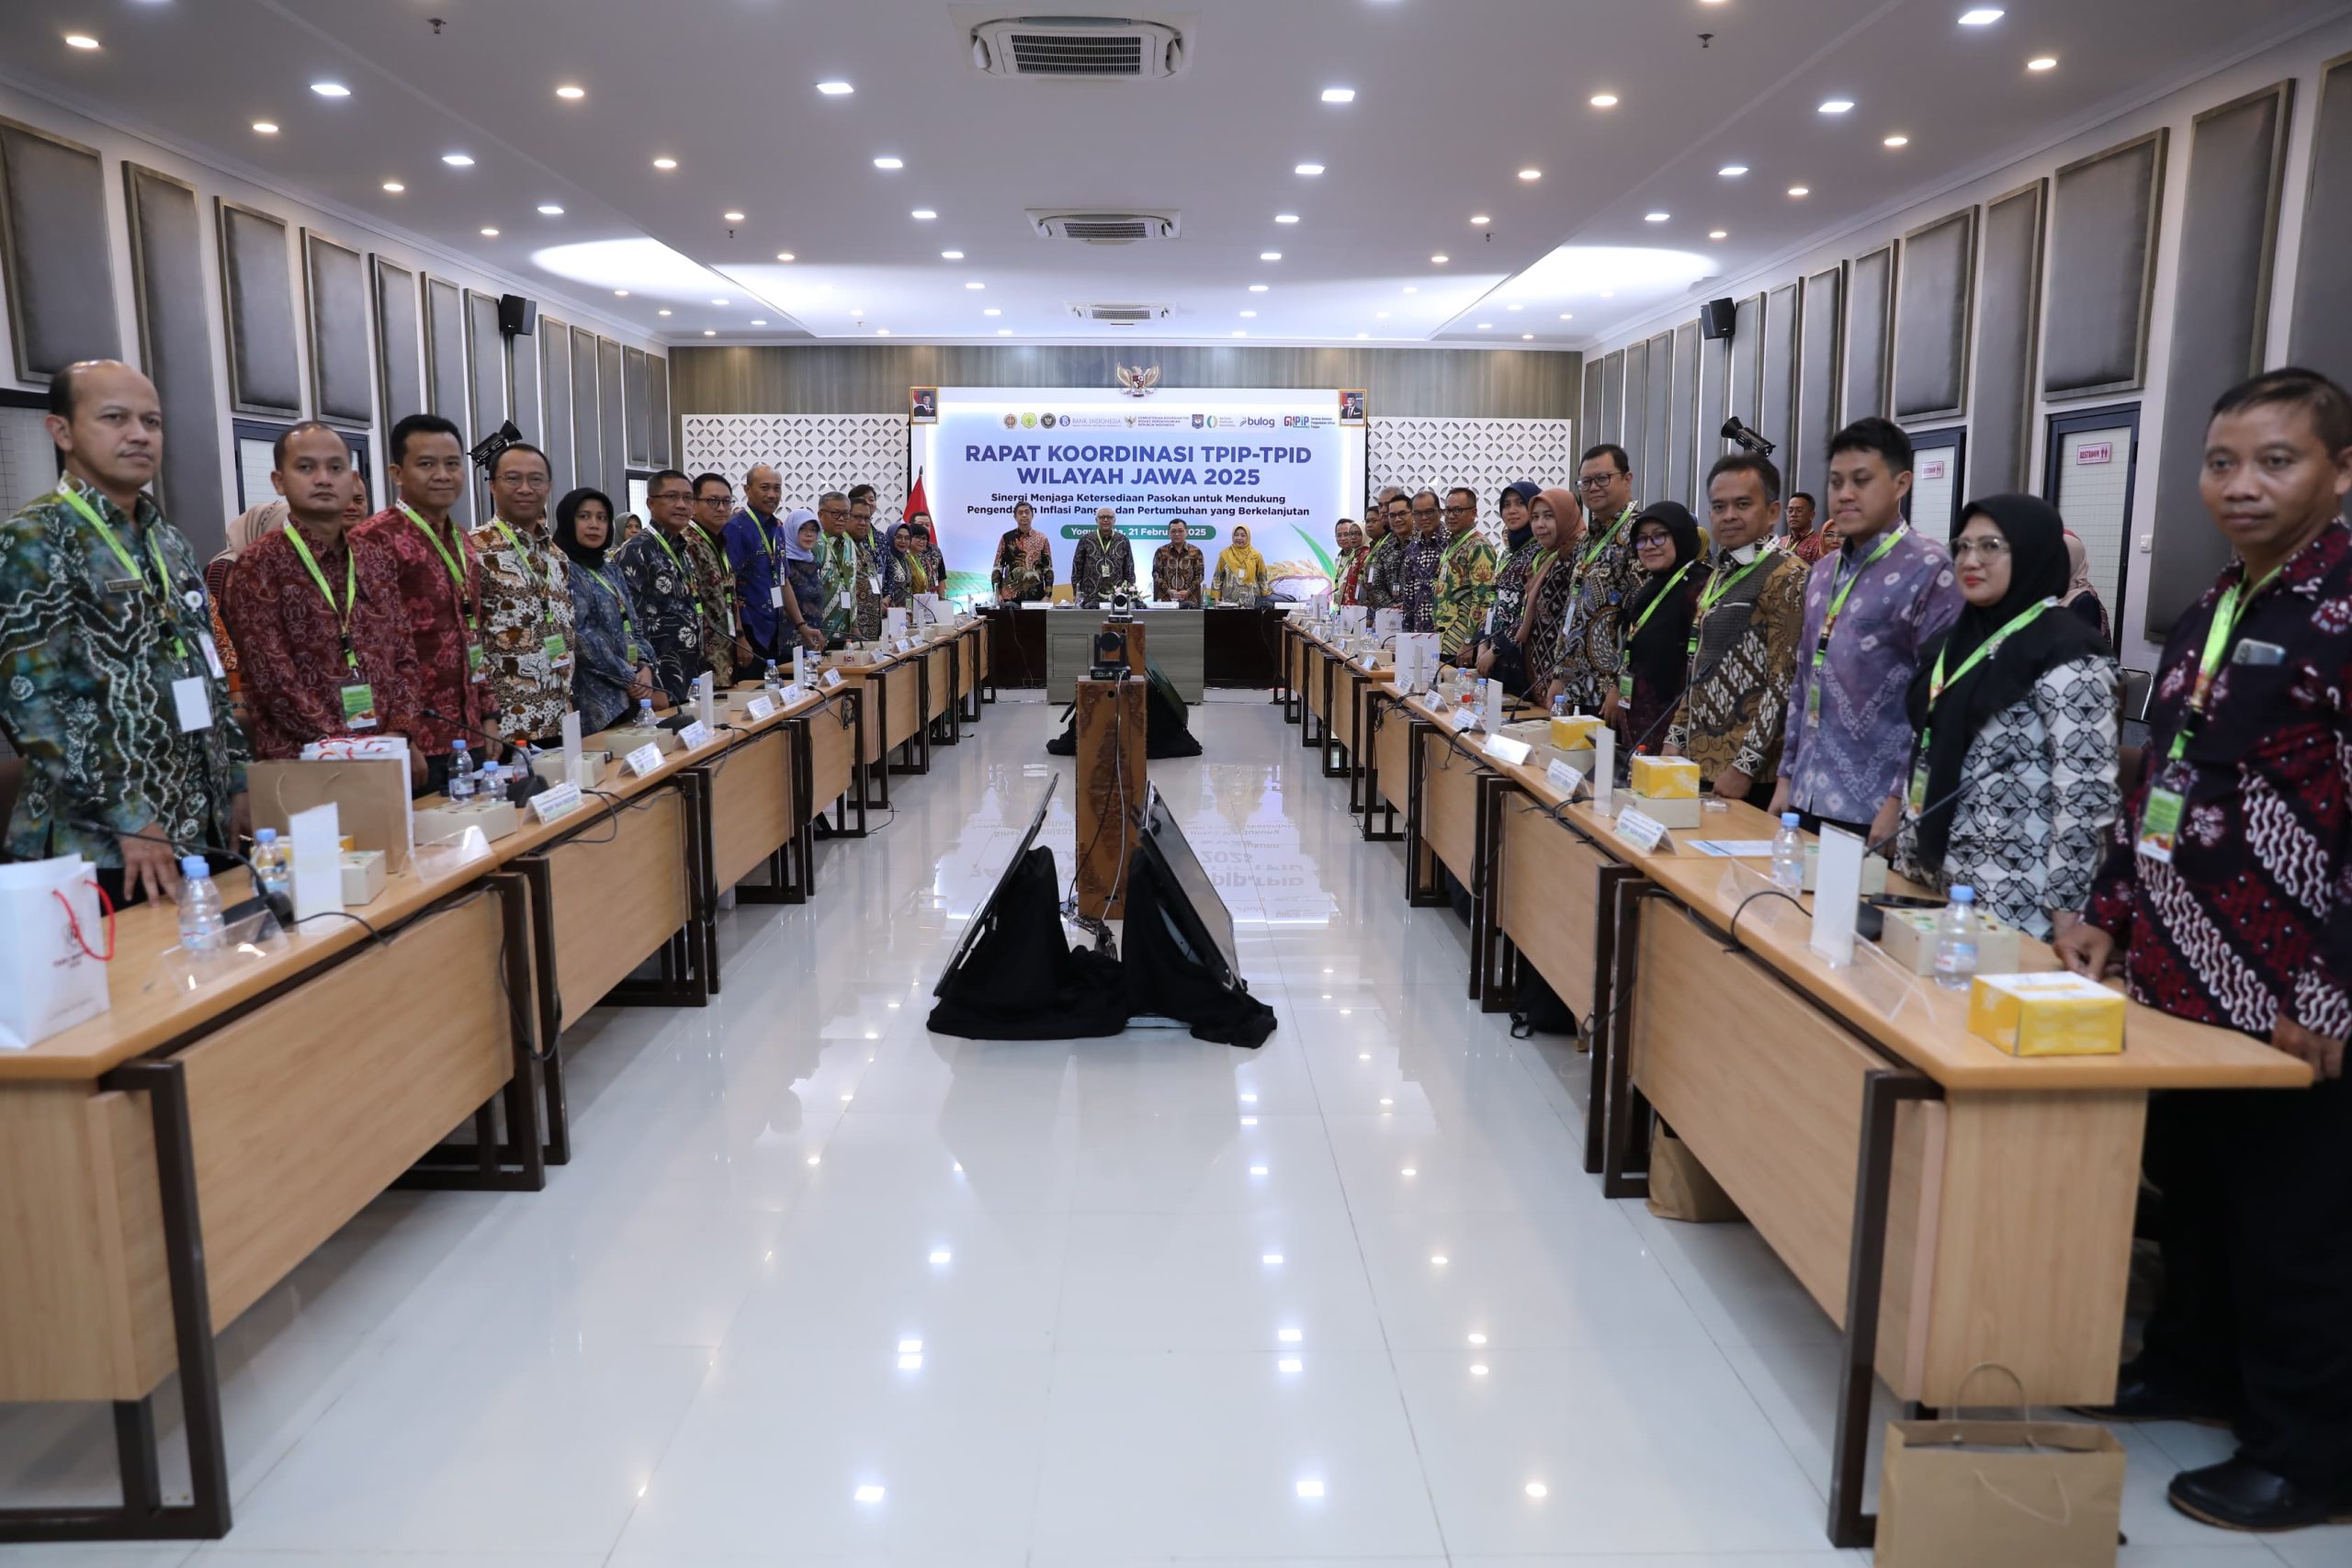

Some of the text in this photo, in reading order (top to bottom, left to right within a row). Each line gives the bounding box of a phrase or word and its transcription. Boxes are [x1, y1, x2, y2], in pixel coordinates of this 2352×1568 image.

[1248, 416, 1275, 428] bulog
[966, 445, 1312, 464] RAPAT KOORDINASI TPIP-TPID
[1017, 468, 1261, 485] WILAYAH JAWA 2025
[991, 493, 1286, 504] Sinergi Menjaga Ketersediaan Pasokan untuk Mendukung
[1040, 505, 1071, 514] Inflasi
[1115, 506, 1135, 514] dan
[1137, 506, 1207, 515] Pertumbuhan
[1210, 508, 1236, 516] yang
[1238, 506, 1310, 516] Berkelanjutan
[1128, 527, 1138, 536] 21
[1140, 527, 1169, 536] Febru
[1187, 528, 1207, 536] 025
